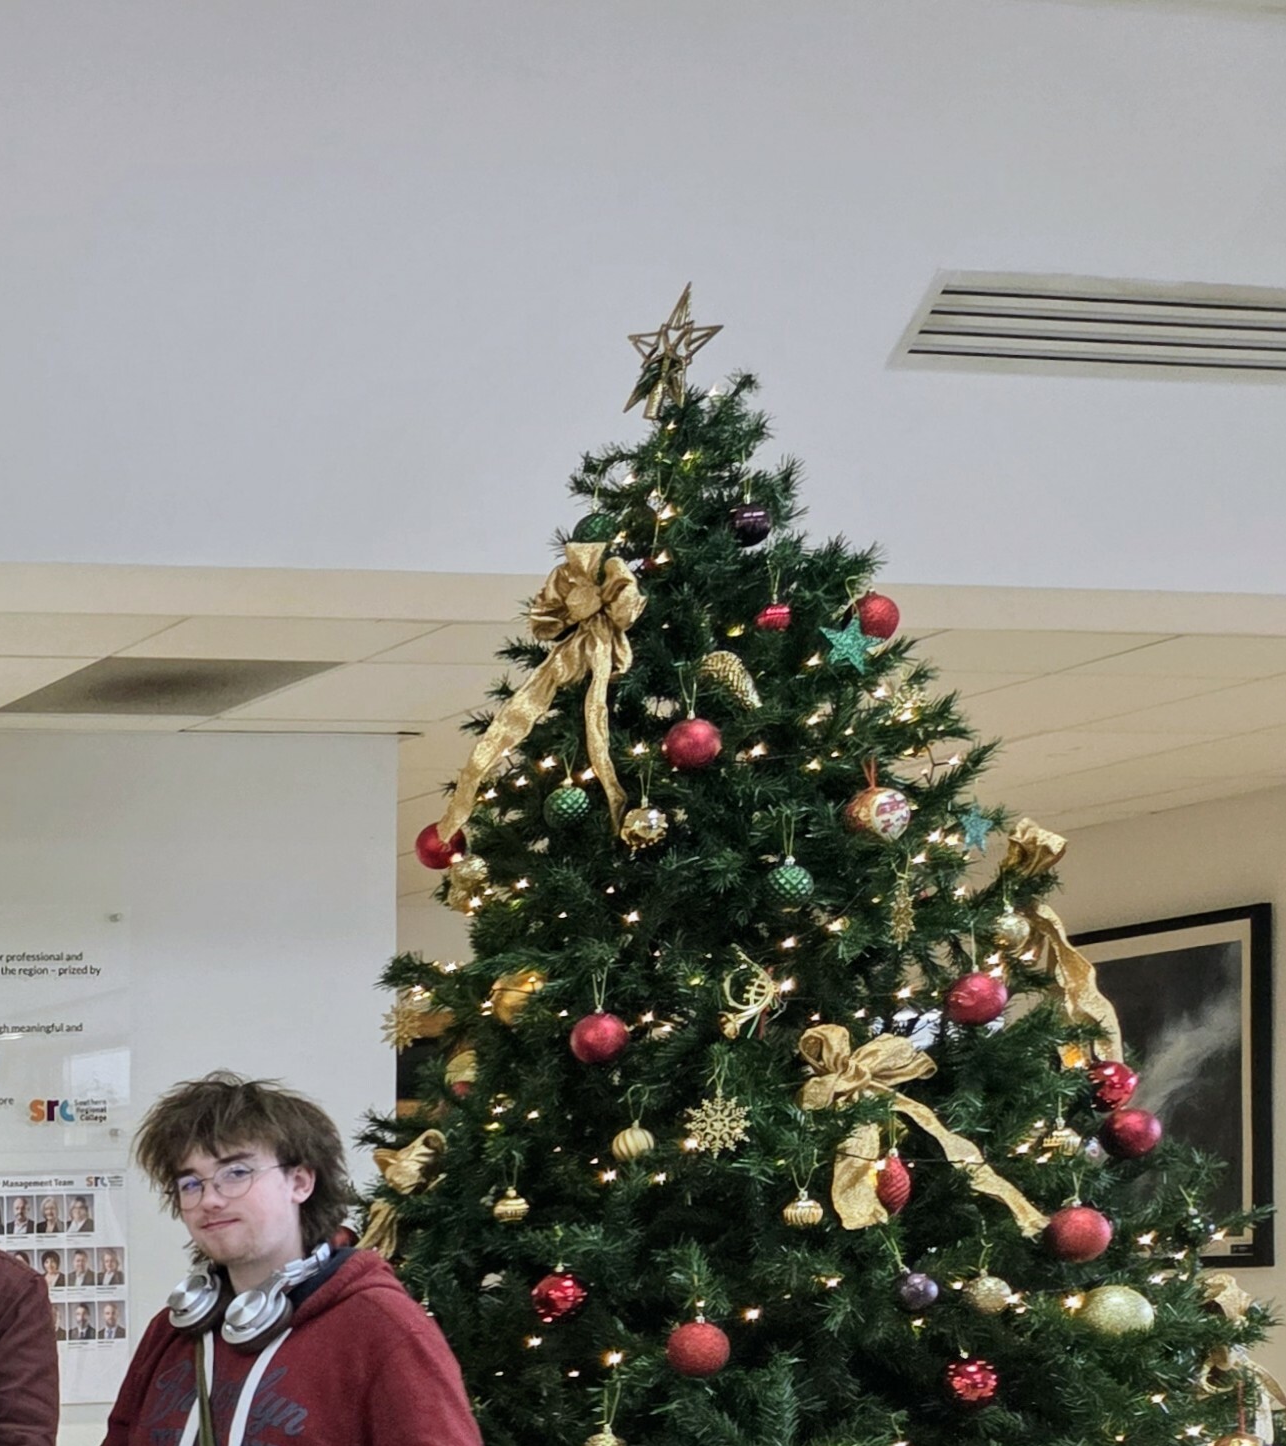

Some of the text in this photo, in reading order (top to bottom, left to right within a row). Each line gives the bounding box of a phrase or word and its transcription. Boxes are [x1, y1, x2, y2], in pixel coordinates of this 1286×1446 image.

[6, 953, 63, 965] professional
[19, 966, 48, 978] region
[11, 1023, 63, 1035] meaningful
[80, 1114, 107, 1123] College
